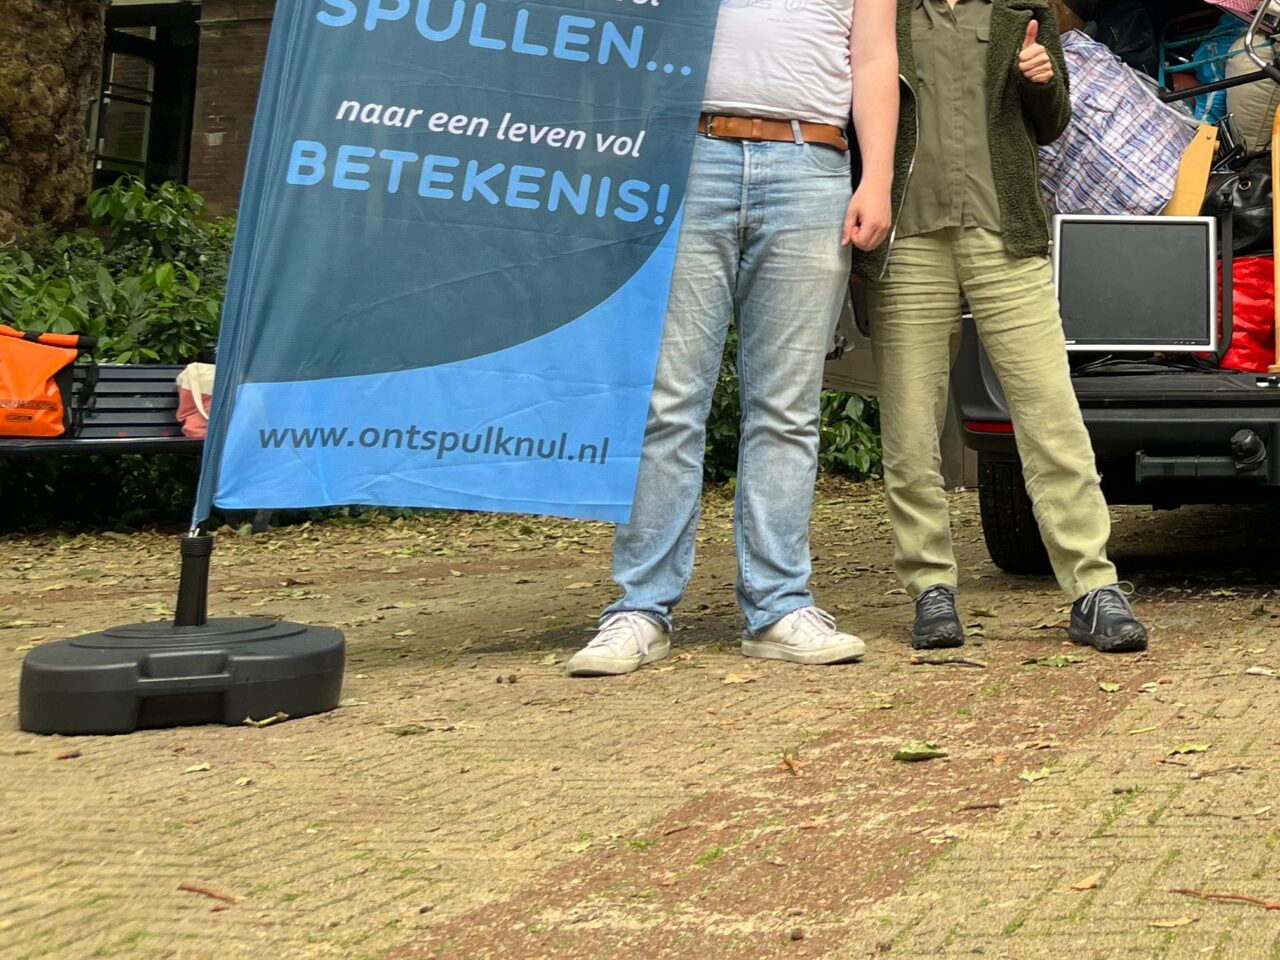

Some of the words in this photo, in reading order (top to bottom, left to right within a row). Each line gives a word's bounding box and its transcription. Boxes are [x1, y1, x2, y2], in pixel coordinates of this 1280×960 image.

[335, 99, 423, 128] naar
[427, 111, 489, 138] een
[496, 112, 587, 150] leven
[596, 131, 646, 157] vol
[286, 140, 670, 226] BETEKENIS!
[258, 424, 610, 465] www.ontspulknul.nl
